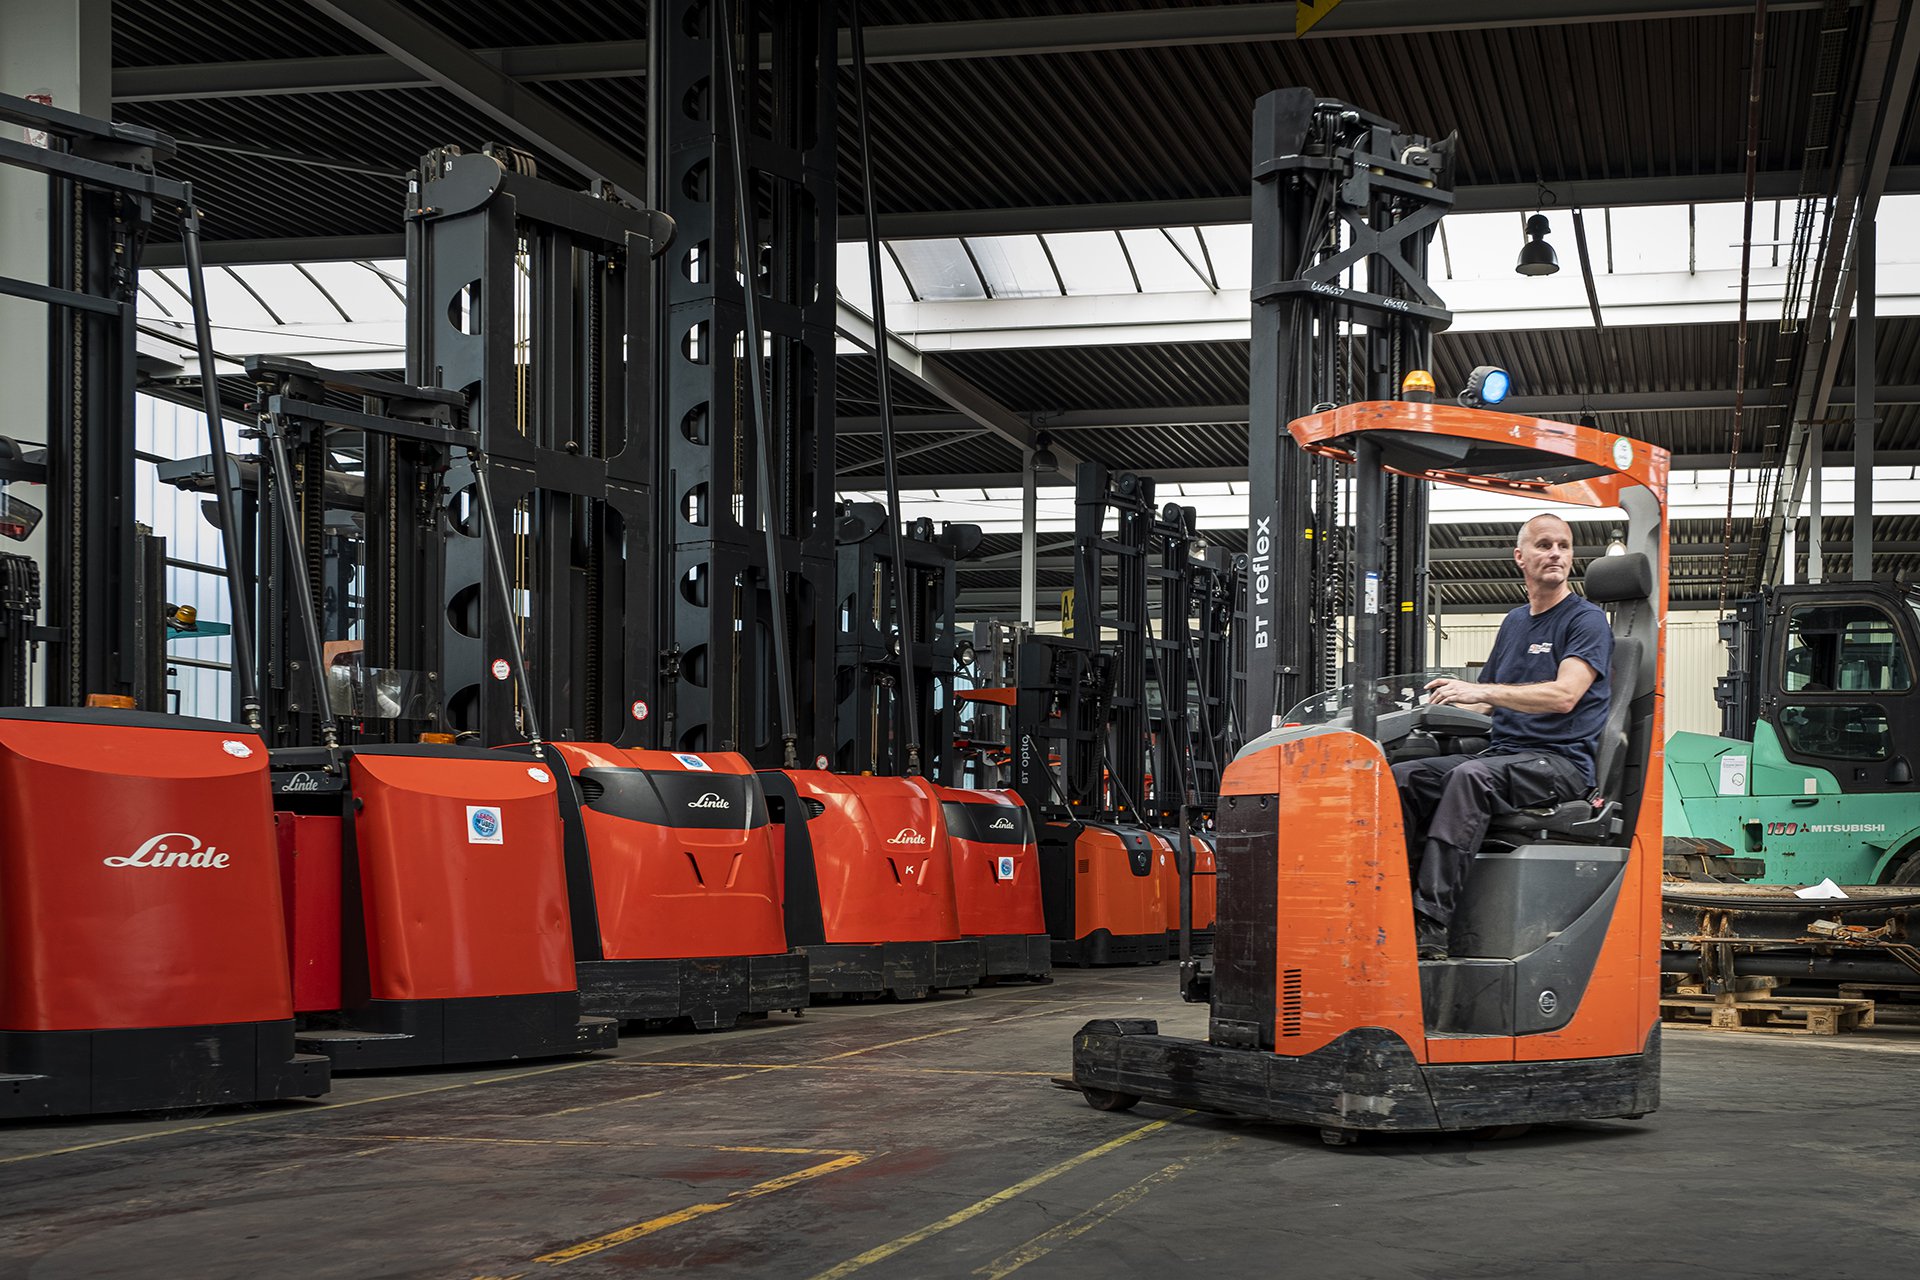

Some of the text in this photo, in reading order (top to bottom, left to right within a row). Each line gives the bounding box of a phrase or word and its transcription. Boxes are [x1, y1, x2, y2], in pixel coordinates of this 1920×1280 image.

[1252, 515, 1270, 649] BT reflex
[1021, 735, 1030, 784] BT optio
[281, 772, 319, 791] Linde
[688, 792, 730, 809] Linde
[989, 817, 1015, 830] Linde
[1767, 822, 1885, 836] 150 MITSUBISHI
[886, 827, 926, 845] Linde
[103, 832, 230, 868] Linde
[905, 865, 914, 875] K
